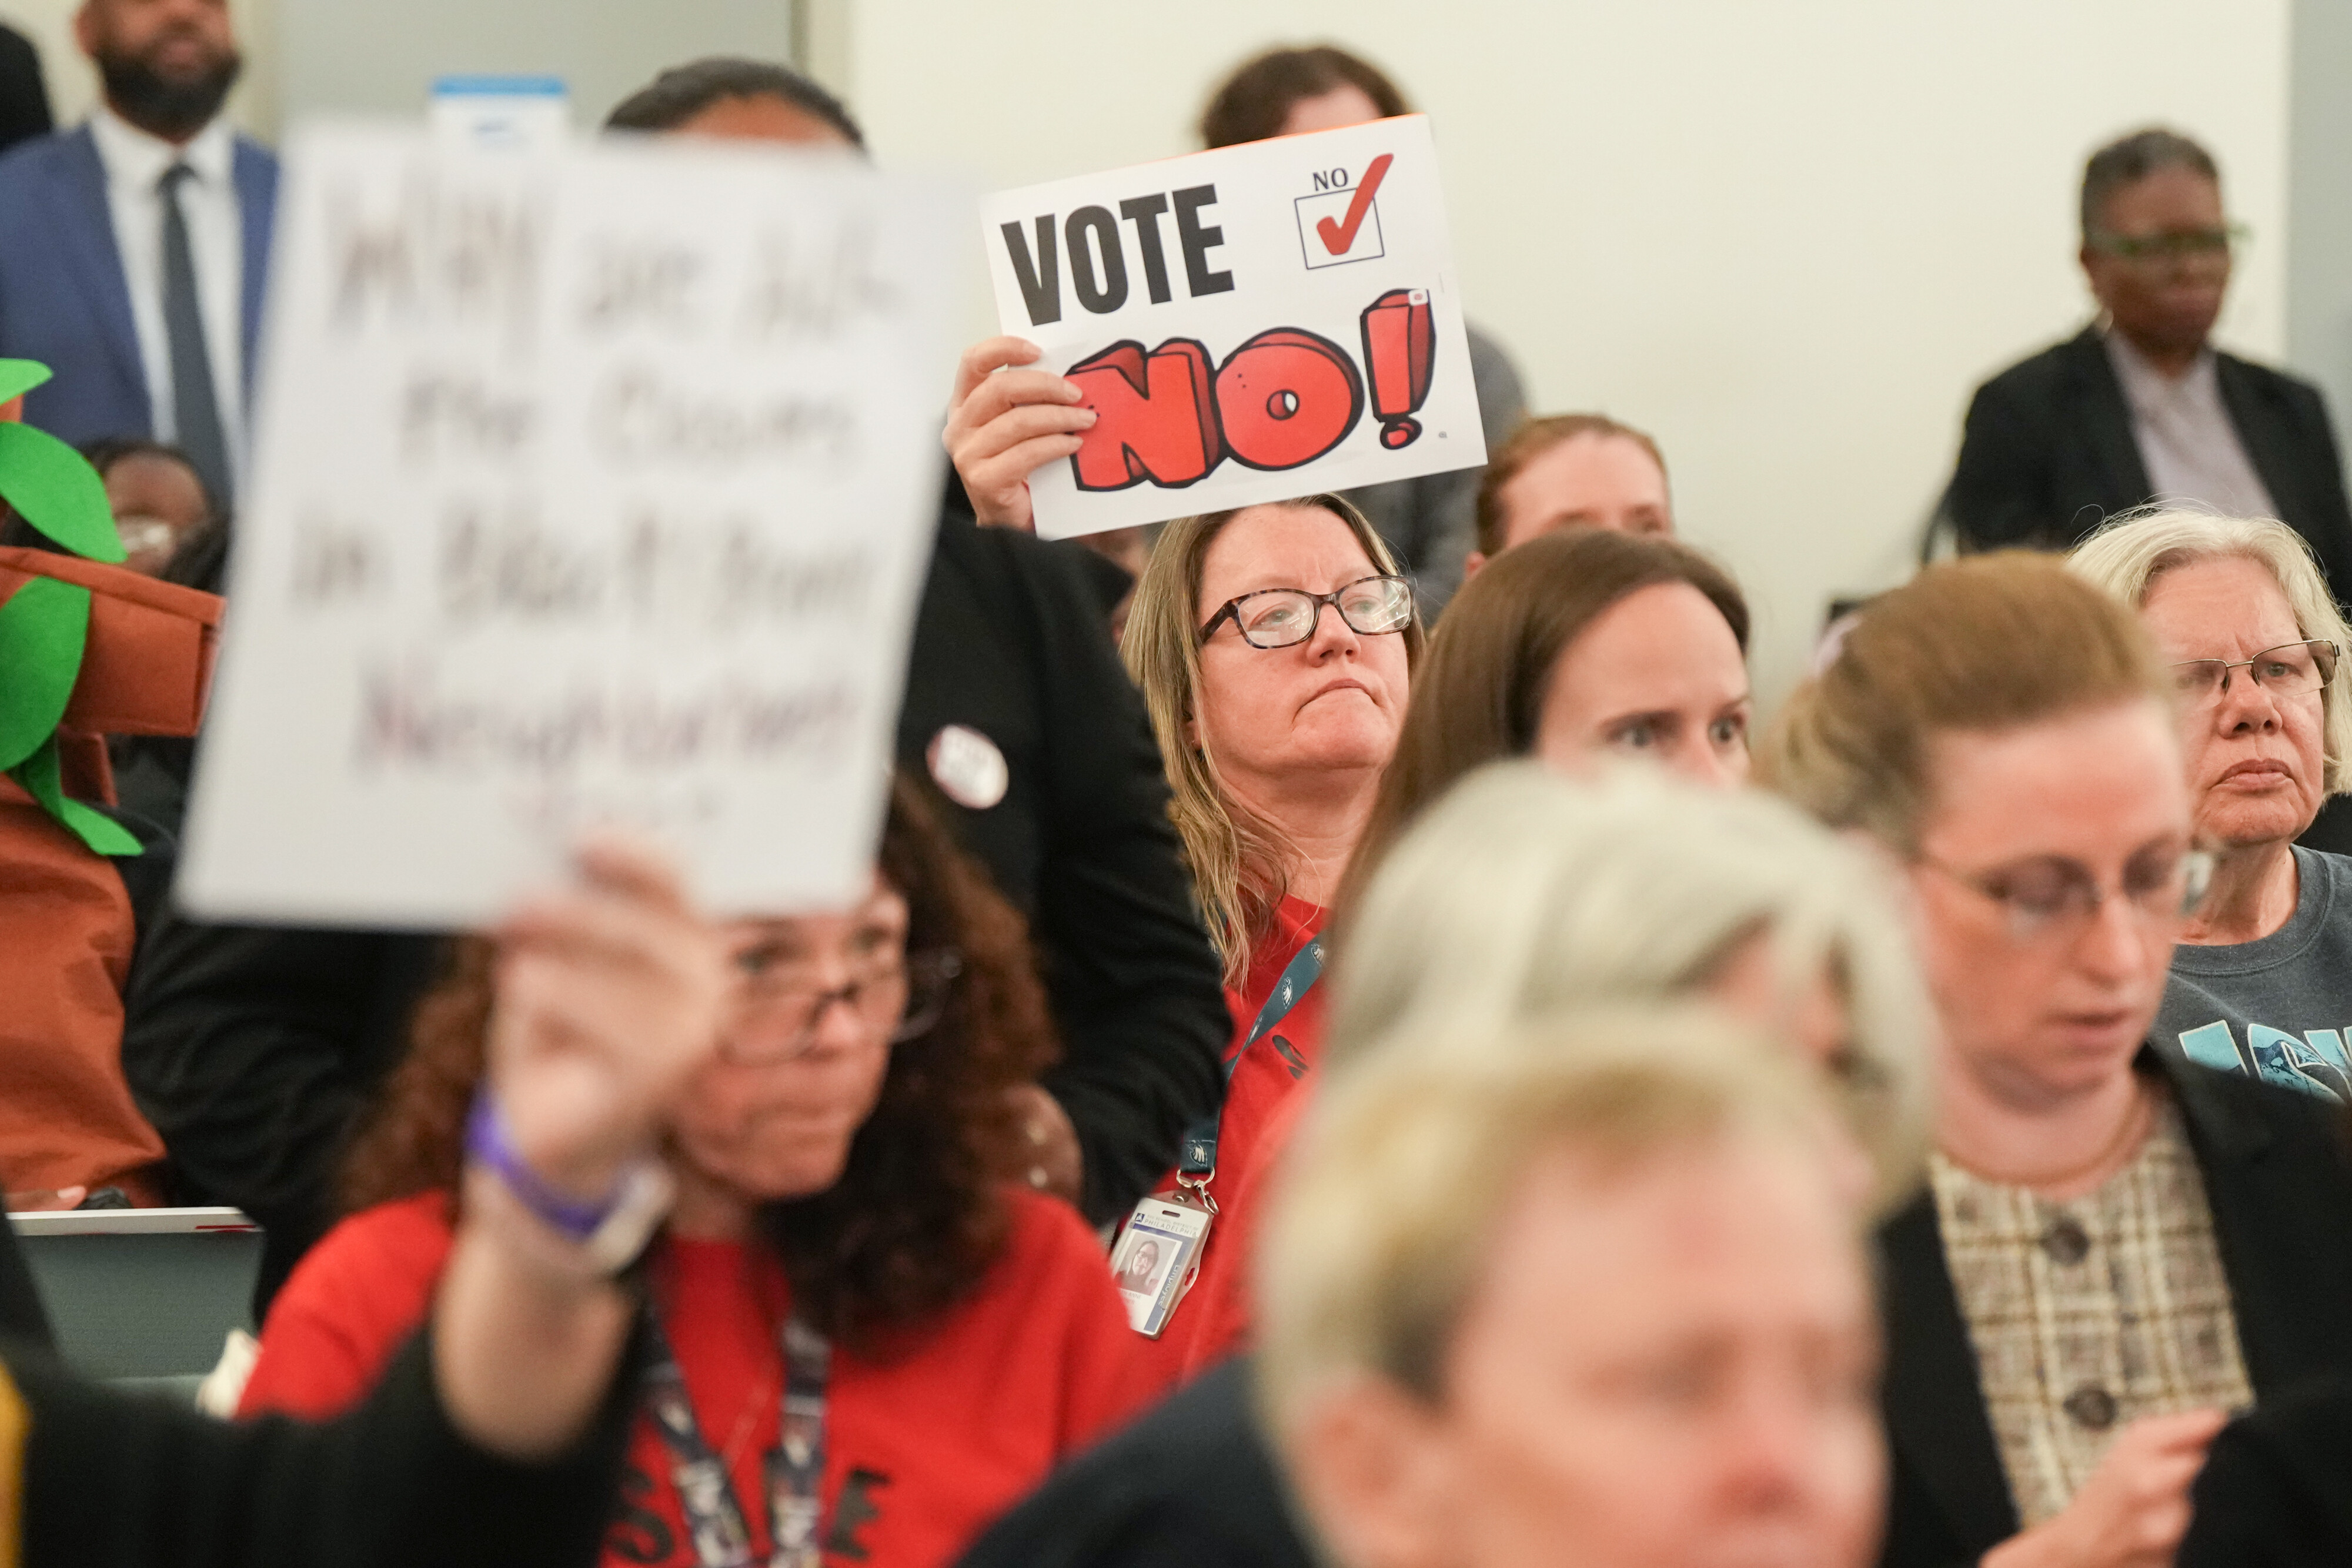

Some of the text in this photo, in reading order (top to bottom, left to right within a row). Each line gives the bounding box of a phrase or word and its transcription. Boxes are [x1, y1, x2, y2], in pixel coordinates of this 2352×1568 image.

[1313, 168, 1348, 191] NO
[1000, 183, 1235, 326] VOTE
[1062, 288, 1436, 492] NO!
[1144, 1219, 1198, 1236] PHILADELPHIA
[1158, 1264, 1181, 1306] Employee
